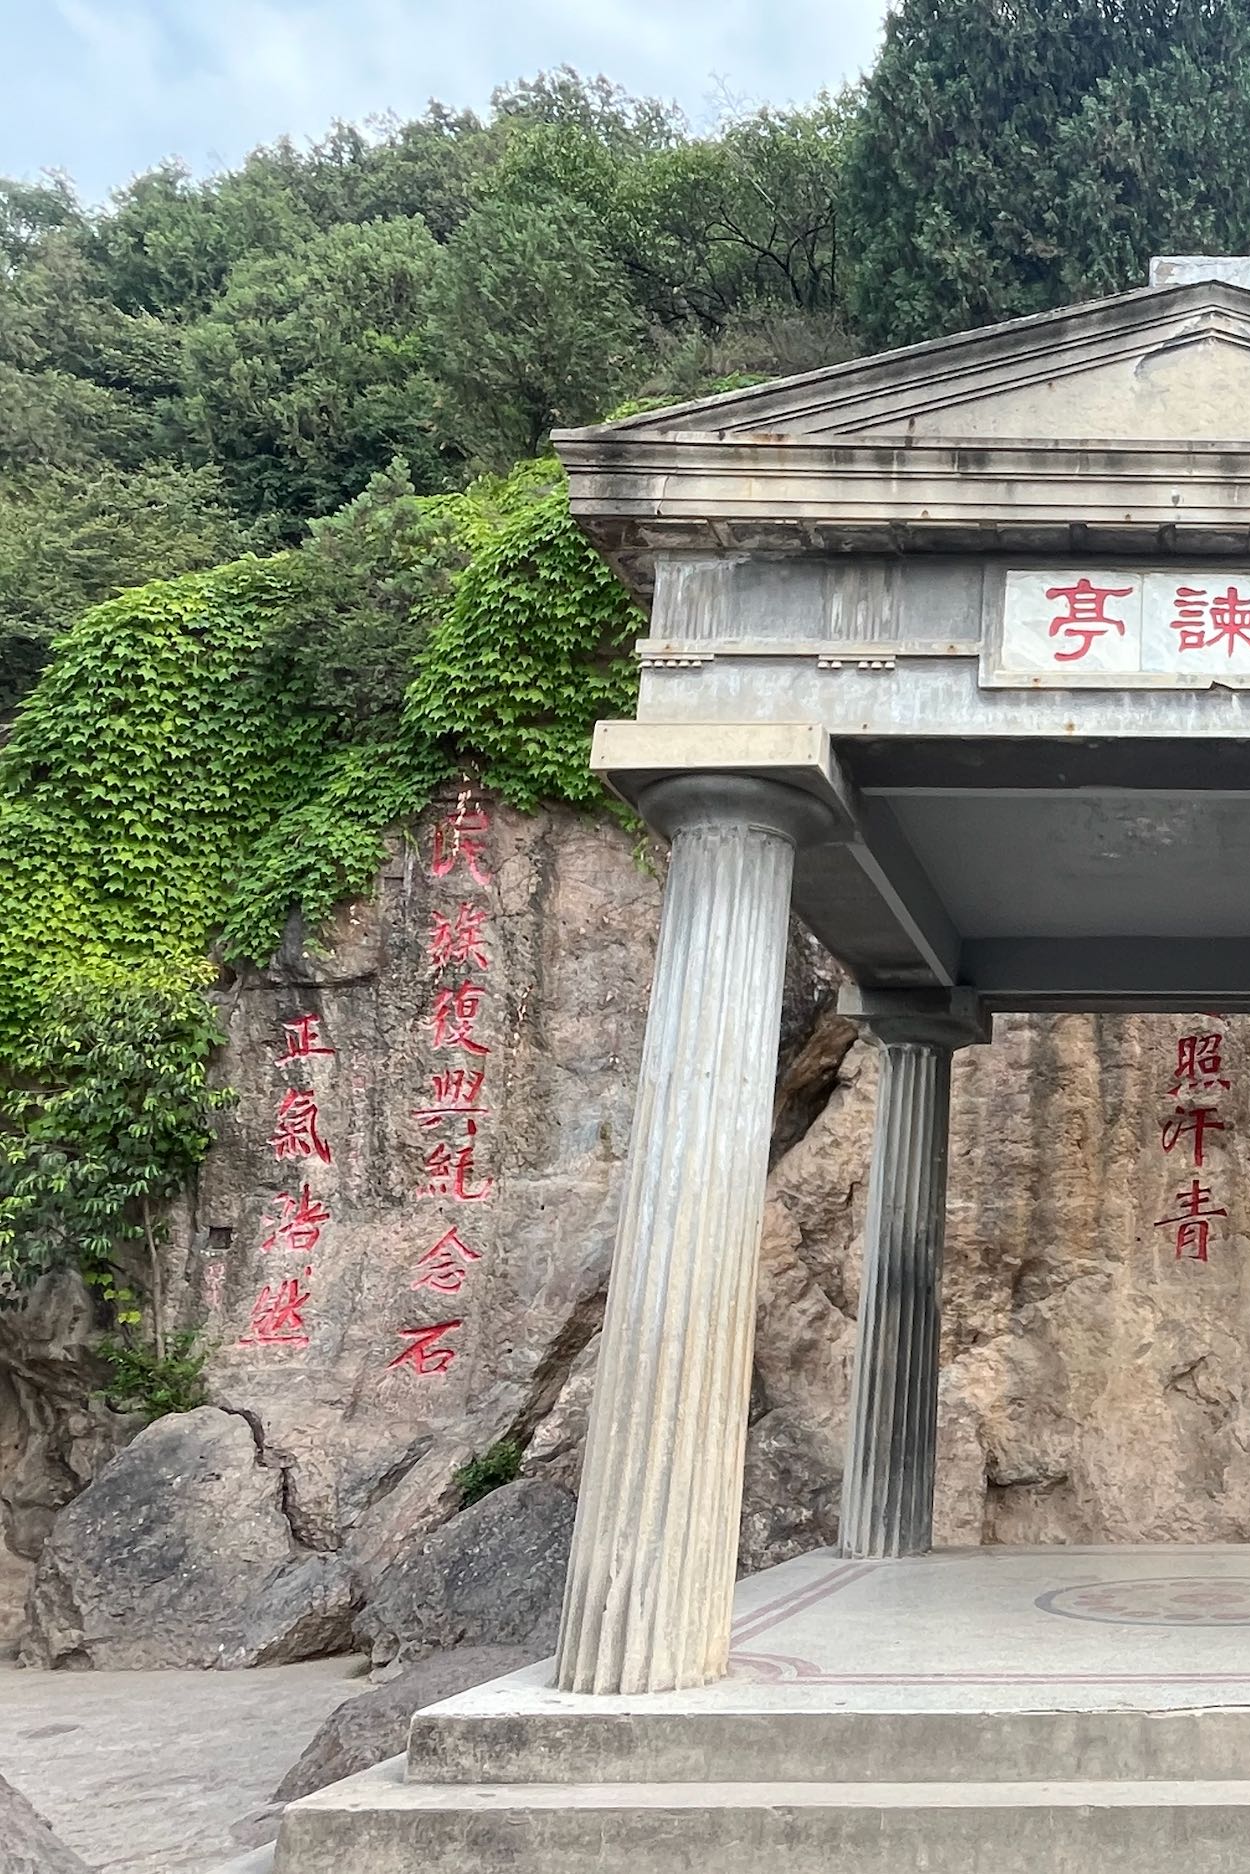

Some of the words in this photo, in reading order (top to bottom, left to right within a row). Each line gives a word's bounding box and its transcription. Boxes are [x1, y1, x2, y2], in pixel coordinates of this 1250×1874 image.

[235, 1012, 336, 1348] 正氣浩然
[1153, 1011, 1231, 1263] 照汗青
